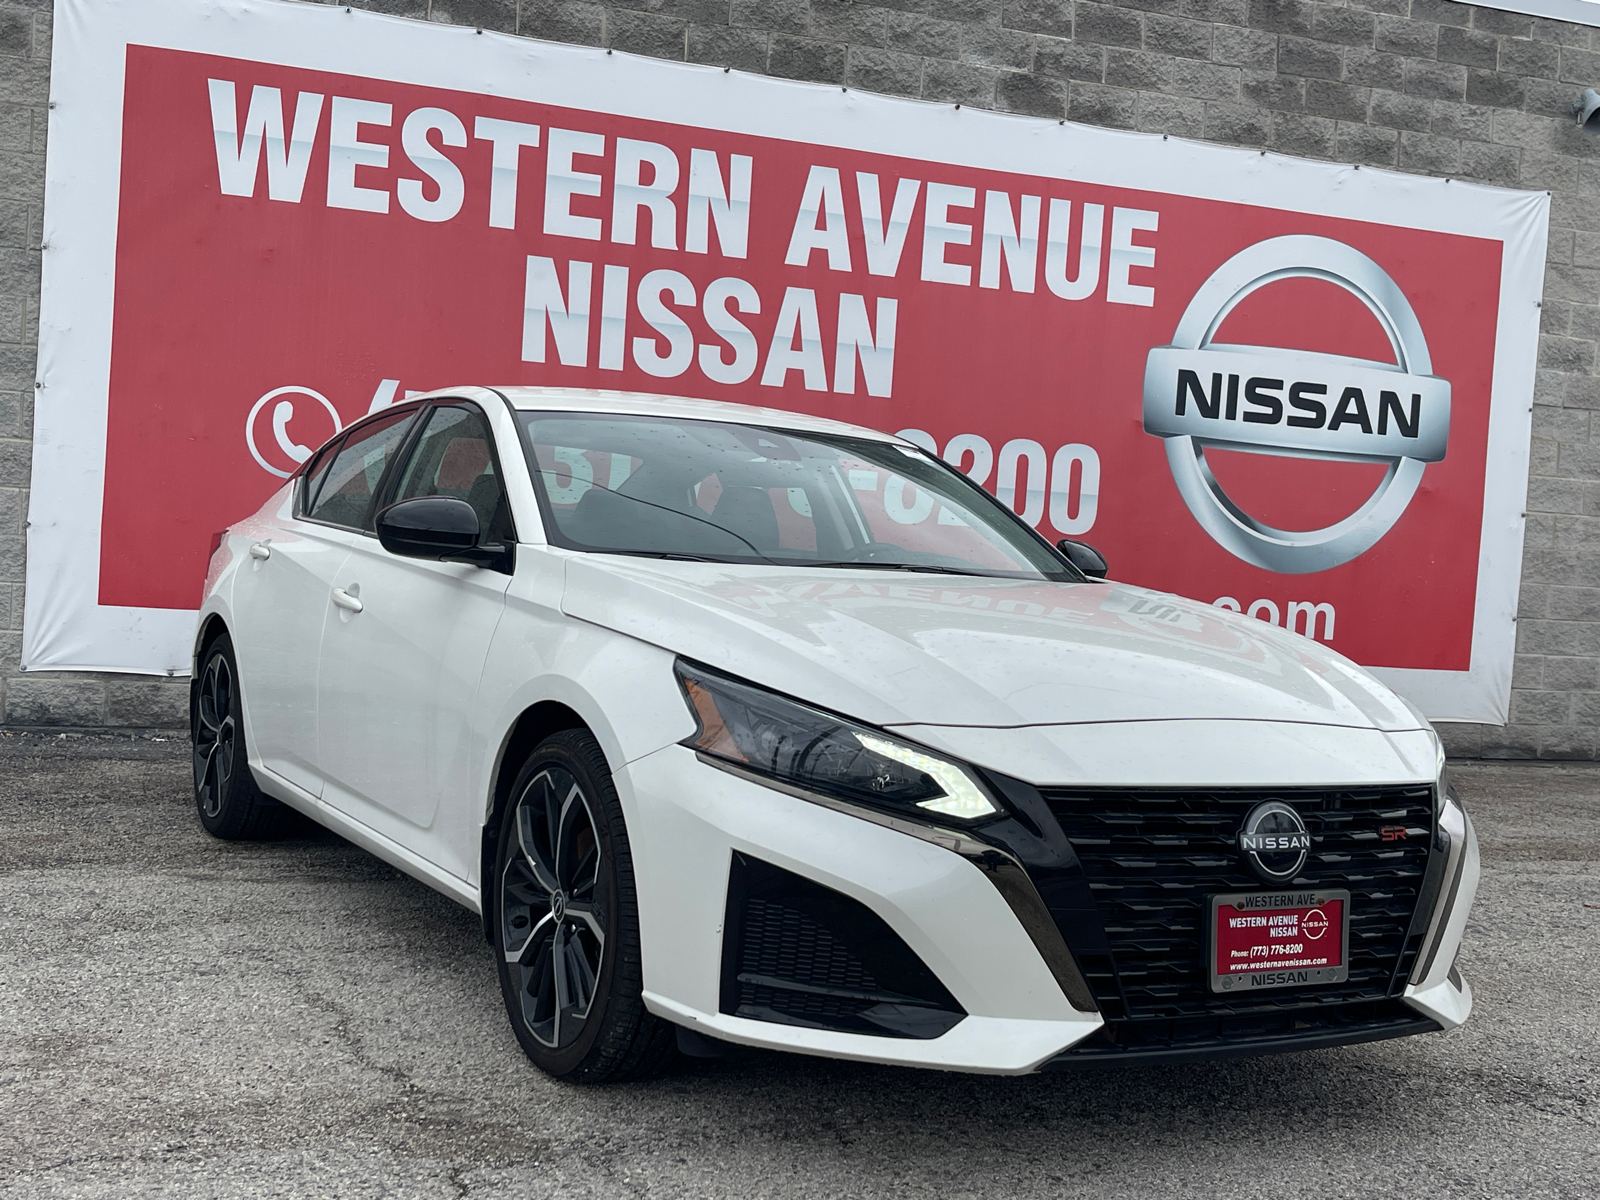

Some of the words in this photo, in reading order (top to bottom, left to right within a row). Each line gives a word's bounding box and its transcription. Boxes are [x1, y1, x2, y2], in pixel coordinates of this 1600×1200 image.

[208, 78, 753, 259] WESTERN
[784, 165, 1159, 307] AVENUE
[521, 255, 898, 398] NISSAN
[1175, 368, 1421, 438] NISSAN
[1381, 826, 1407, 841] SR
[1243, 834, 1310, 850] NISSAN
[1245, 894, 1294, 908] WESTERN
[1297, 893, 1318, 906] AVE.
[1229, 916, 1267, 928] WESTERN
[1268, 915, 1298, 926] AVENUE
[1301, 920, 1329, 928] NISSAN
[1270, 926, 1298, 938] NISSAN
[1231, 950, 1249, 958] Phone:
[1250, 945, 1269, 959] (773)
[1270, 944, 1303, 956] 776-8200
[1230, 958, 1328, 971] www.westernavenissan.com
[1251, 971, 1308, 987] NISSAN
